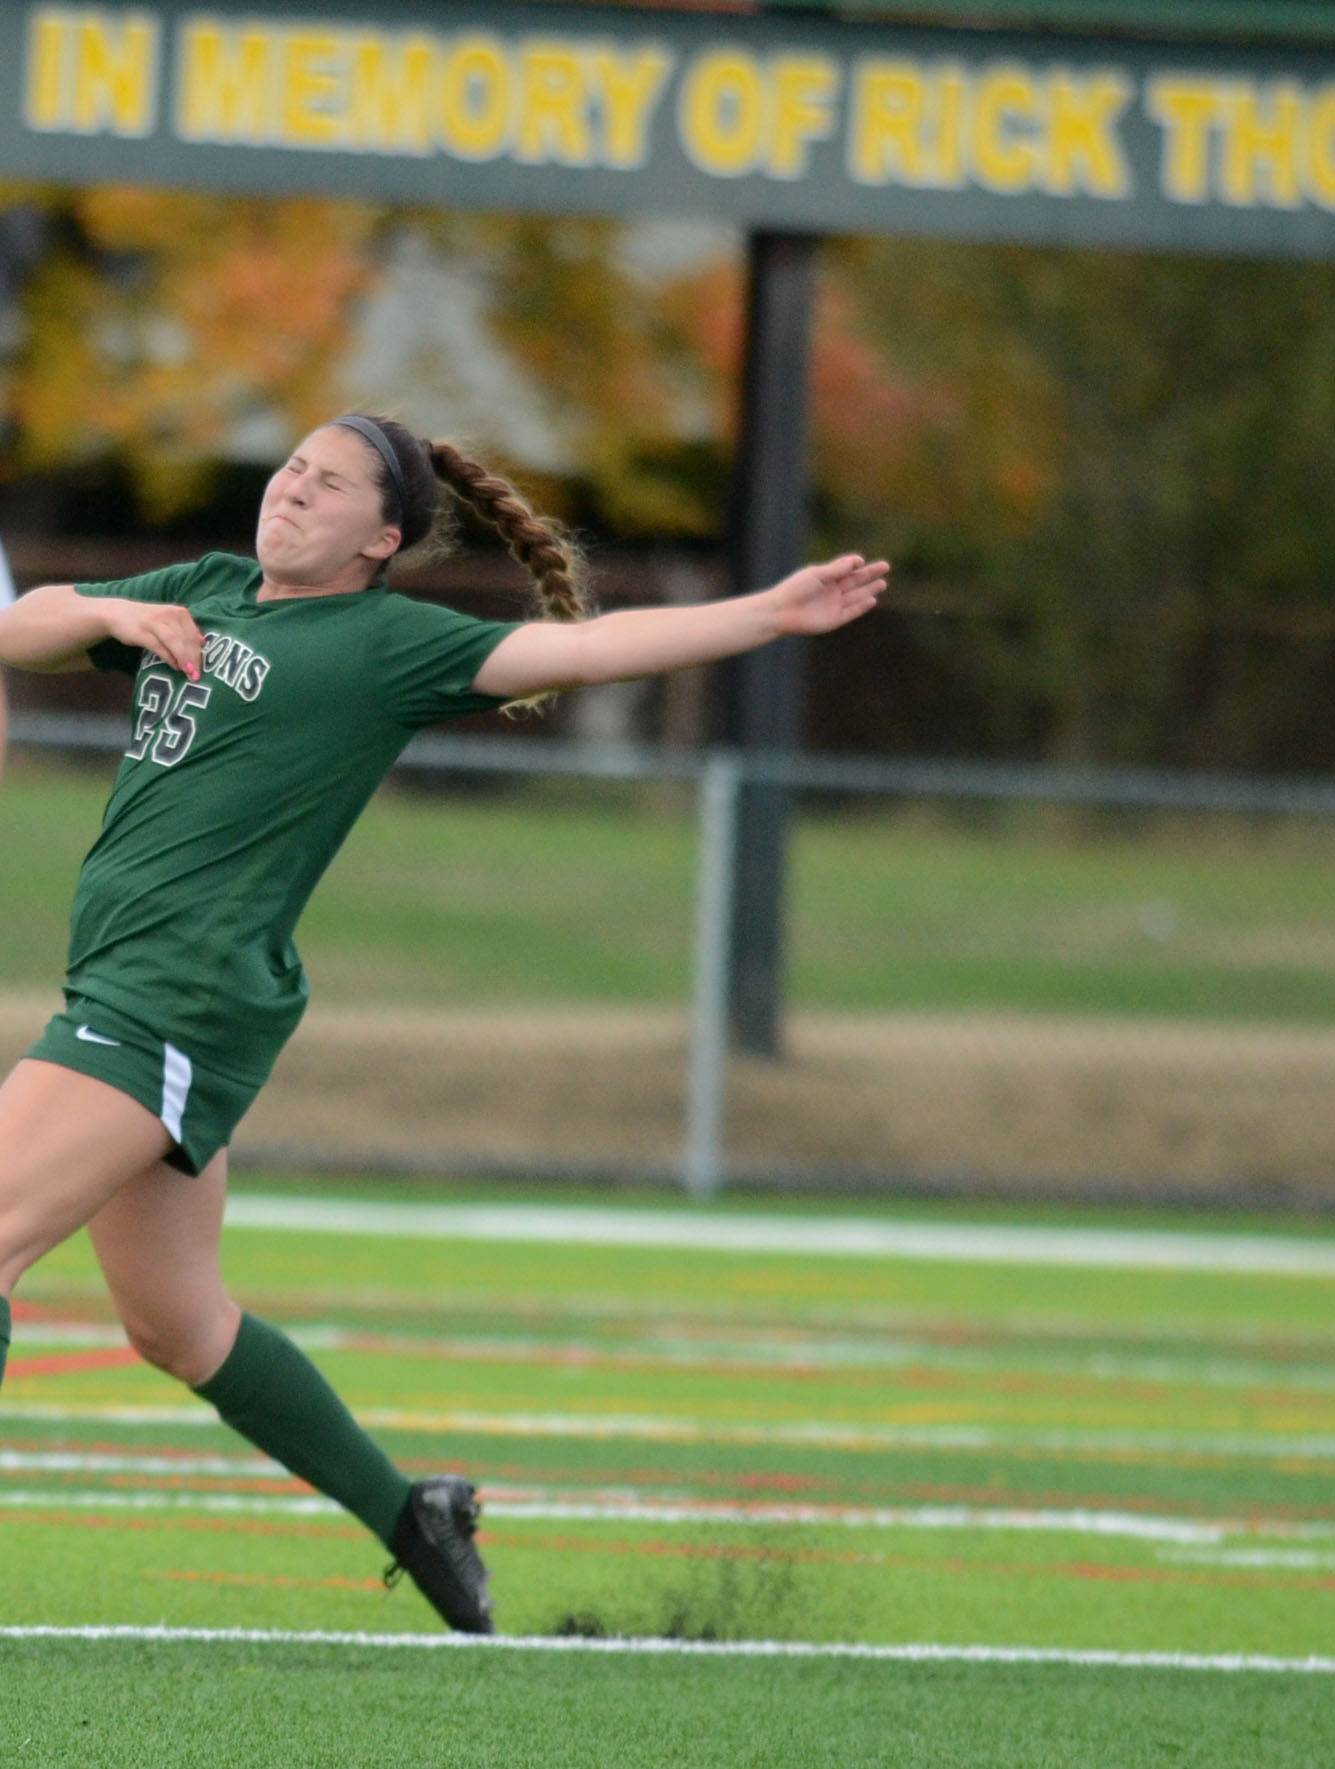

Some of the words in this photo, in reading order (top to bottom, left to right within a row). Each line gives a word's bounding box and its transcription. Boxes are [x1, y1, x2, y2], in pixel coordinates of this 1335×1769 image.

[26, 11, 157, 138] IN
[175, 17, 670, 169] MEMORY
[677, 44, 840, 180] OF
[848, 52, 1134, 199] RICK
[124, 674, 213, 767] 25
